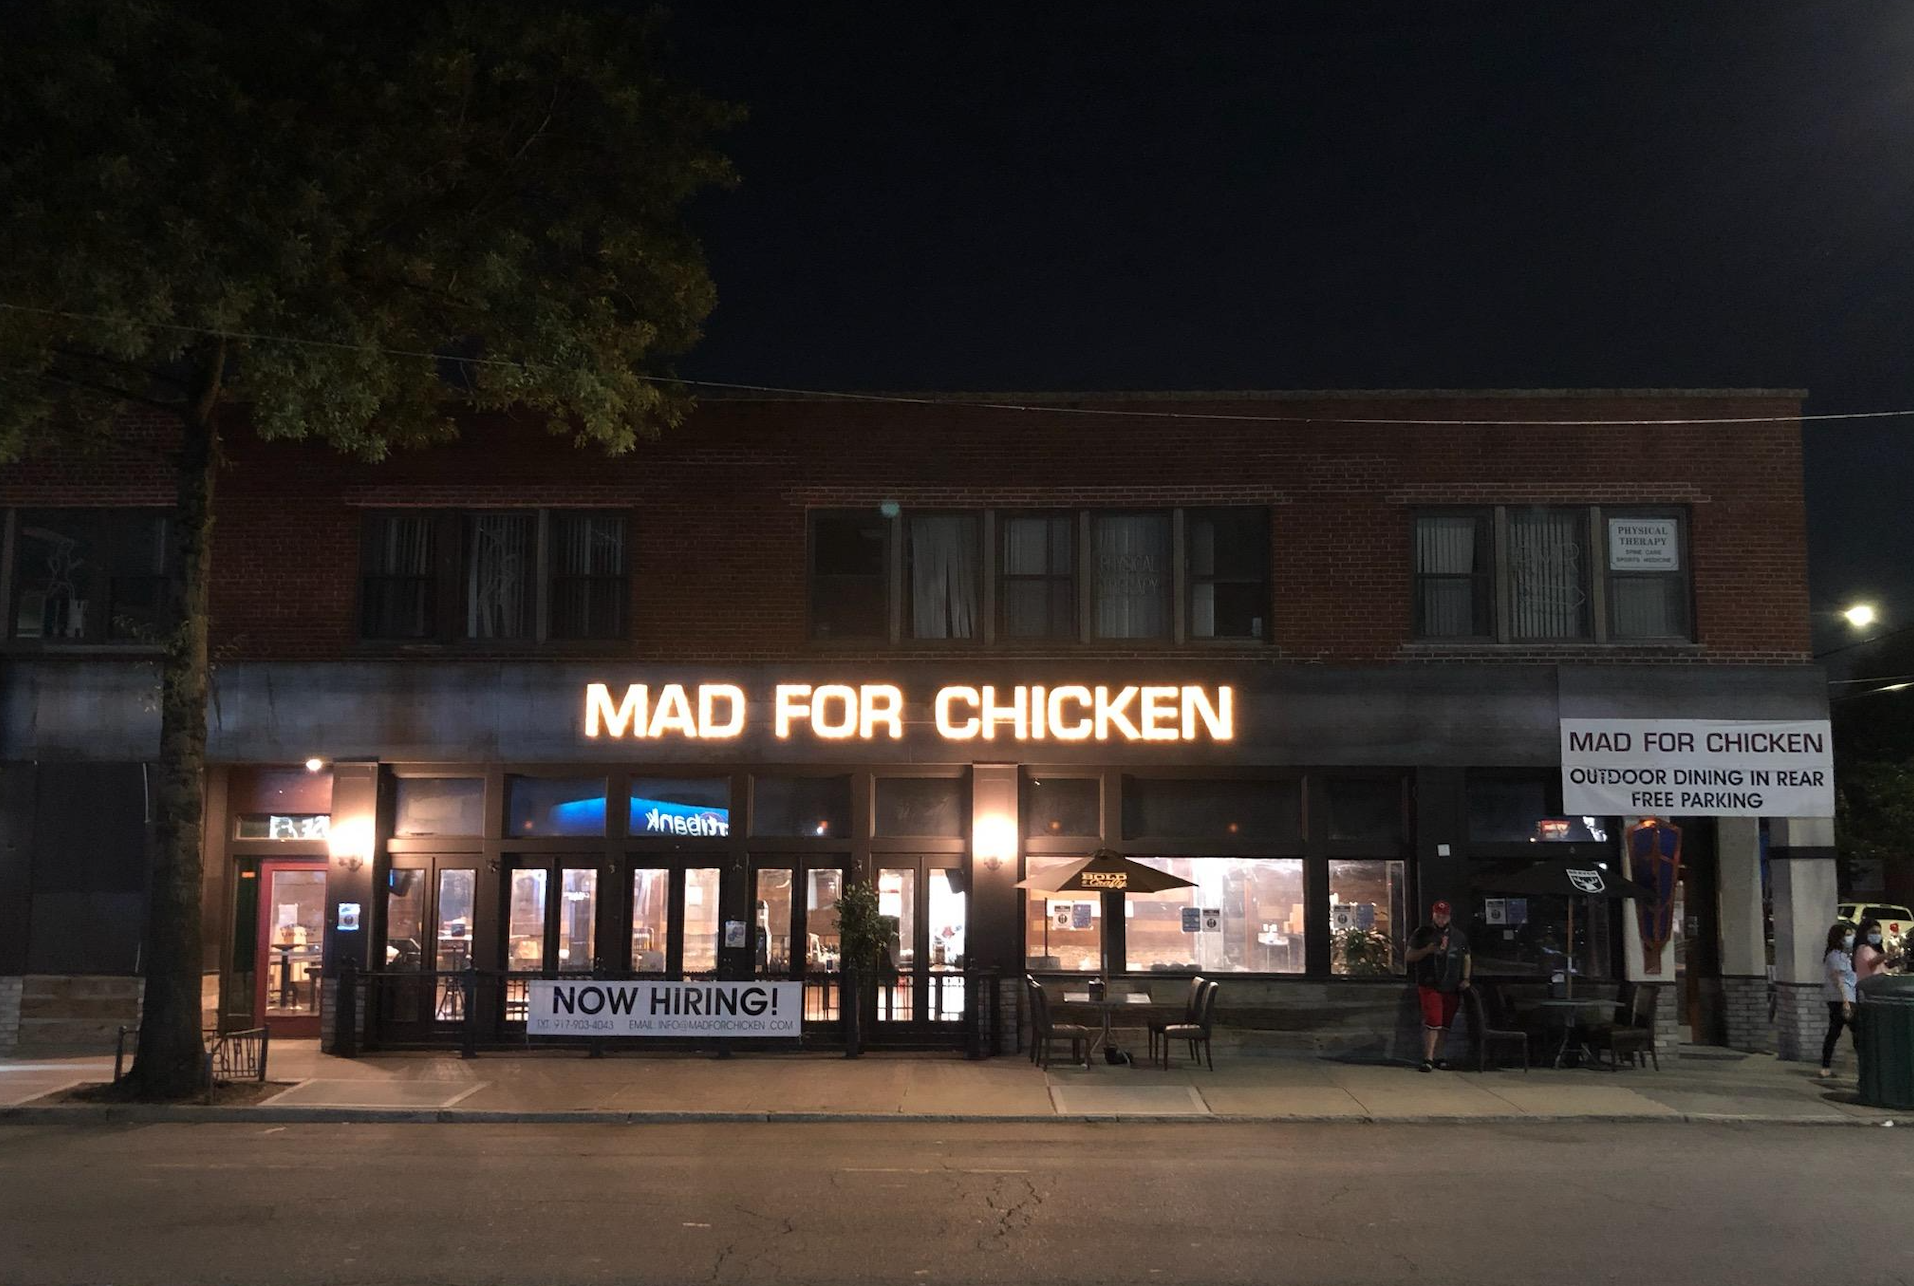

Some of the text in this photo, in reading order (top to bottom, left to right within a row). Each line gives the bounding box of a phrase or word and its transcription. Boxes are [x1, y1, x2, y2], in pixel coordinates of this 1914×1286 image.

[1617, 526, 1668, 535] PHYSICAL
[1620, 538, 1667, 546] THERAPY
[585, 683, 1233, 741] MAD FOR CHICKEN
[1569, 732, 1823, 753] MAD FOR CHICKEN
[1570, 768, 1824, 787] OUTDOOR DINING IN REAR
[1631, 791, 1763, 809] FREE PARKING
[552, 986, 778, 1016] NOW HIRING!
